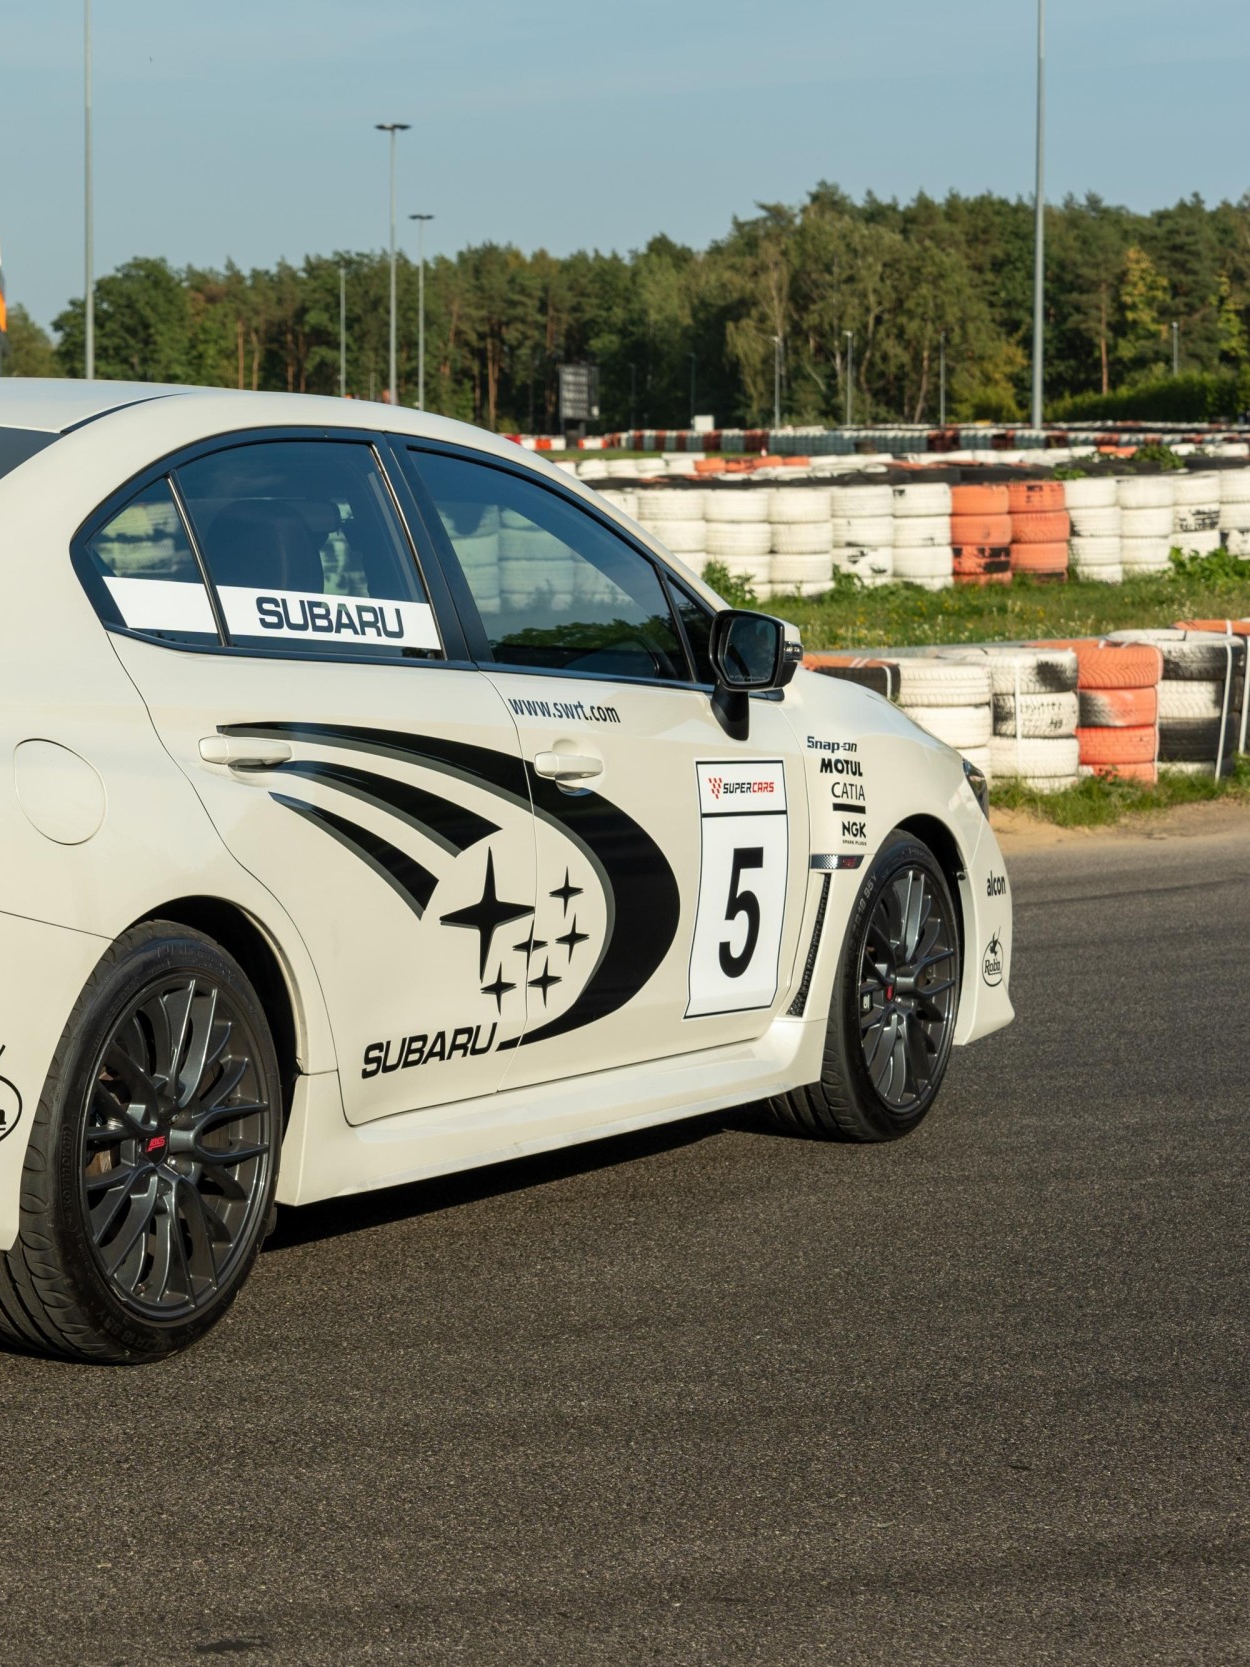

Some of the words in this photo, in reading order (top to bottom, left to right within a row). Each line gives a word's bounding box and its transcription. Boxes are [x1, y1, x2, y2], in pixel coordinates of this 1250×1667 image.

[256, 596, 404, 639] SUBARU
[508, 698, 621, 723] www.swrt.com
[807, 735, 857, 754] Snap-on
[819, 757, 863, 777] MOTUL
[831, 782, 866, 801] CATIA
[841, 820, 867, 838] NGK
[986, 870, 1007, 897] alcon
[719, 846, 764, 979] 5
[361, 1021, 498, 1079] SUBARU
